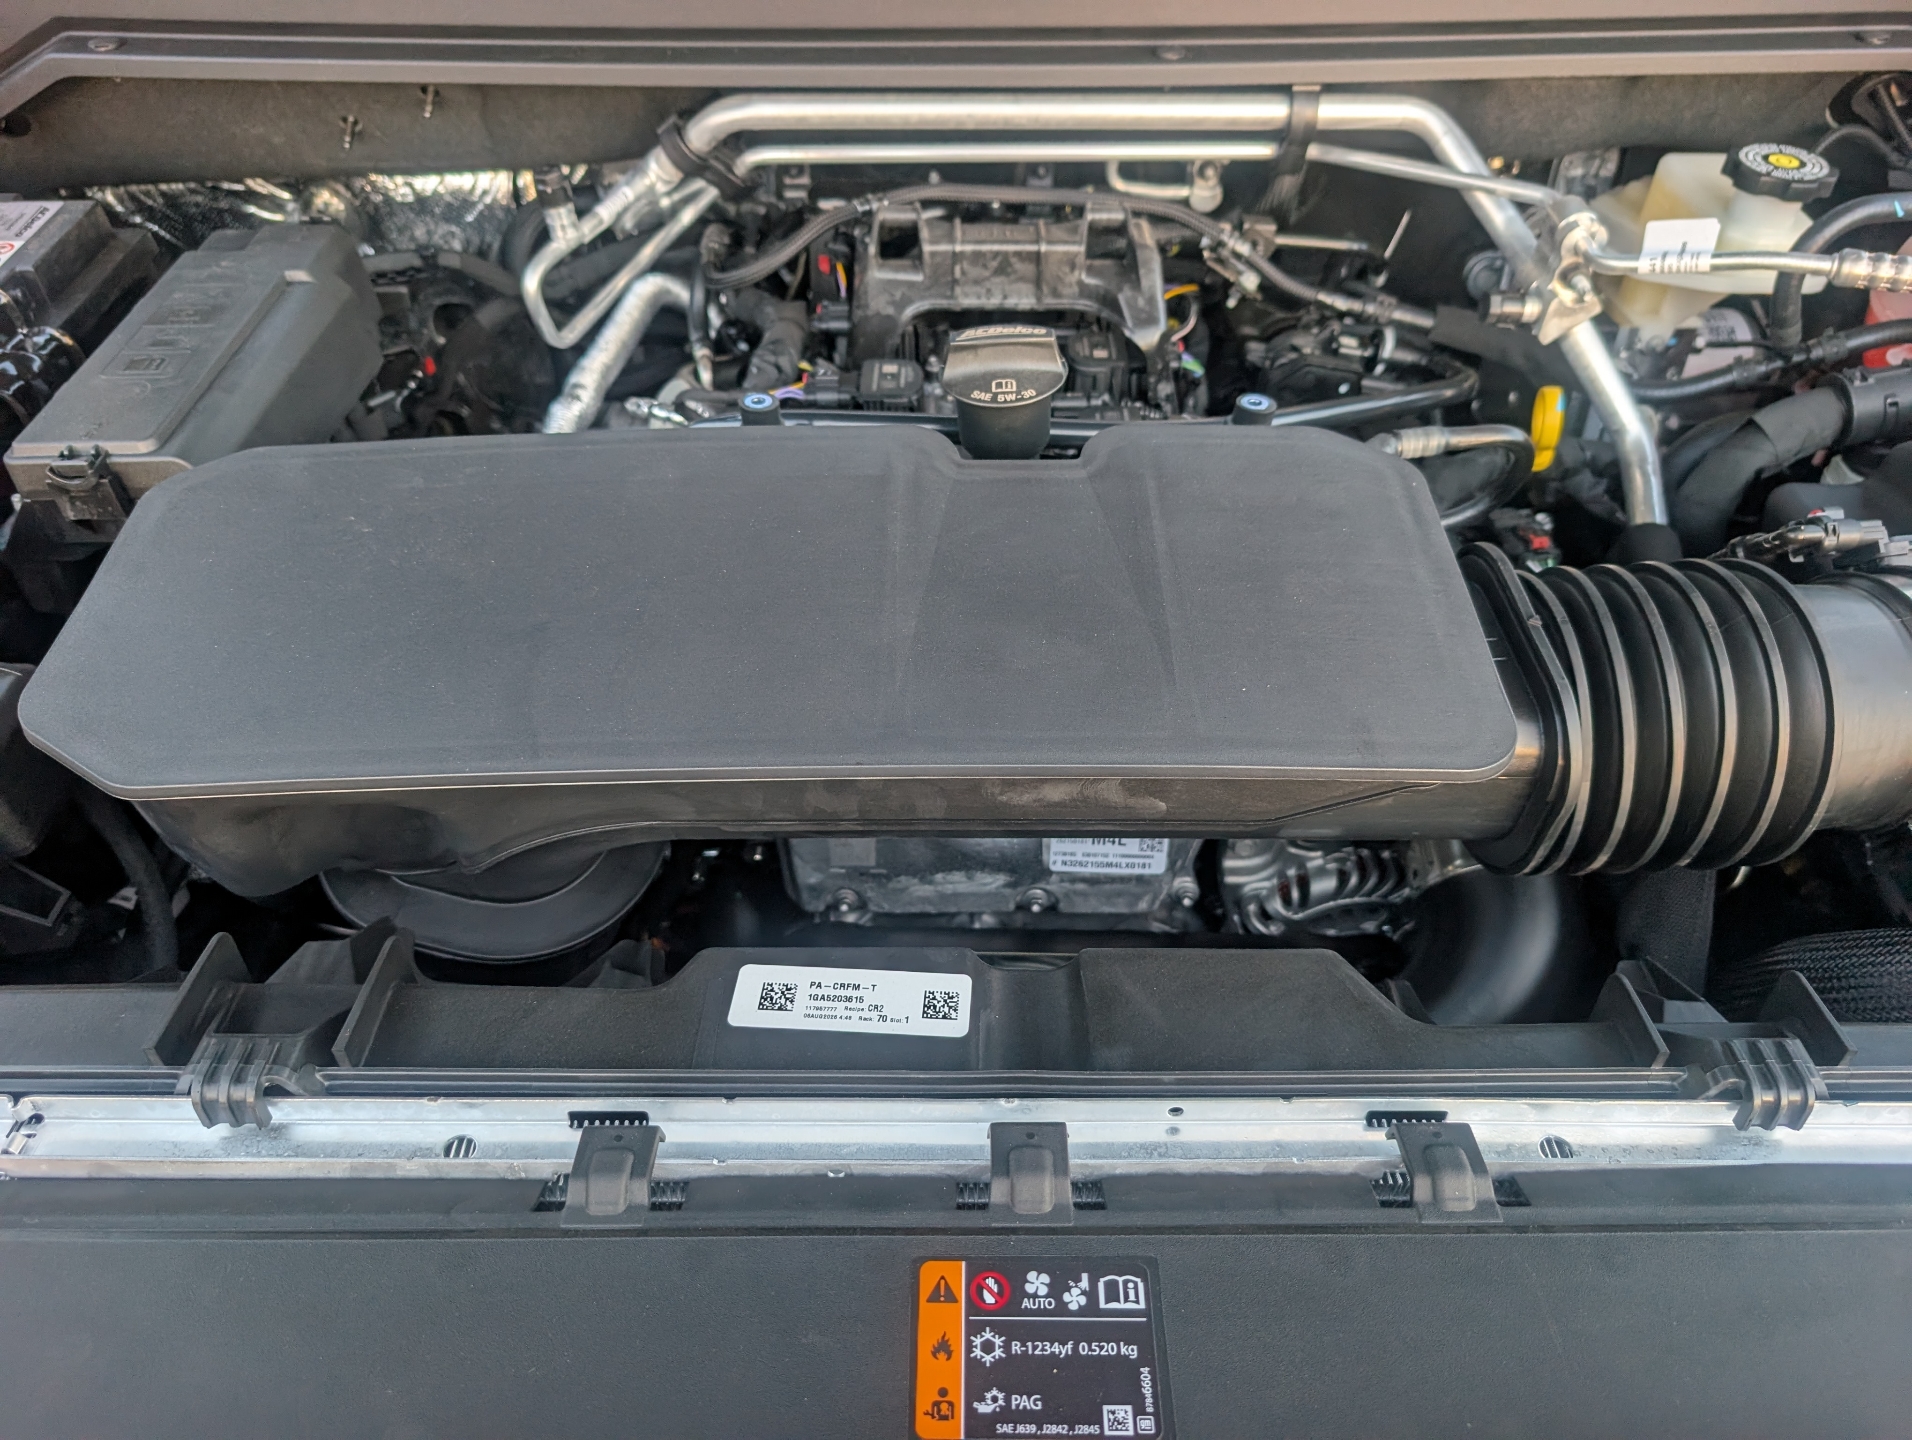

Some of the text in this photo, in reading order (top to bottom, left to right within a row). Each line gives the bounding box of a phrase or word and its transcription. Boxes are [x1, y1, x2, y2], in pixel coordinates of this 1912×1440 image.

[957, 327, 1047, 339] ACDelco
[970, 389, 1037, 402] SAE 5W-30
[867, 1003, 884, 1013] CR2
[876, 1014, 888, 1023] 70
[1021, 1298, 1056, 1310] AUTO
[1011, 1341, 1138, 1359] R-1234yf 0.520 kg
[1011, 1394, 1043, 1410] PAG
[995, 1423, 1014, 1434] SAE
[1073, 1424, 1100, 1435] J2845
